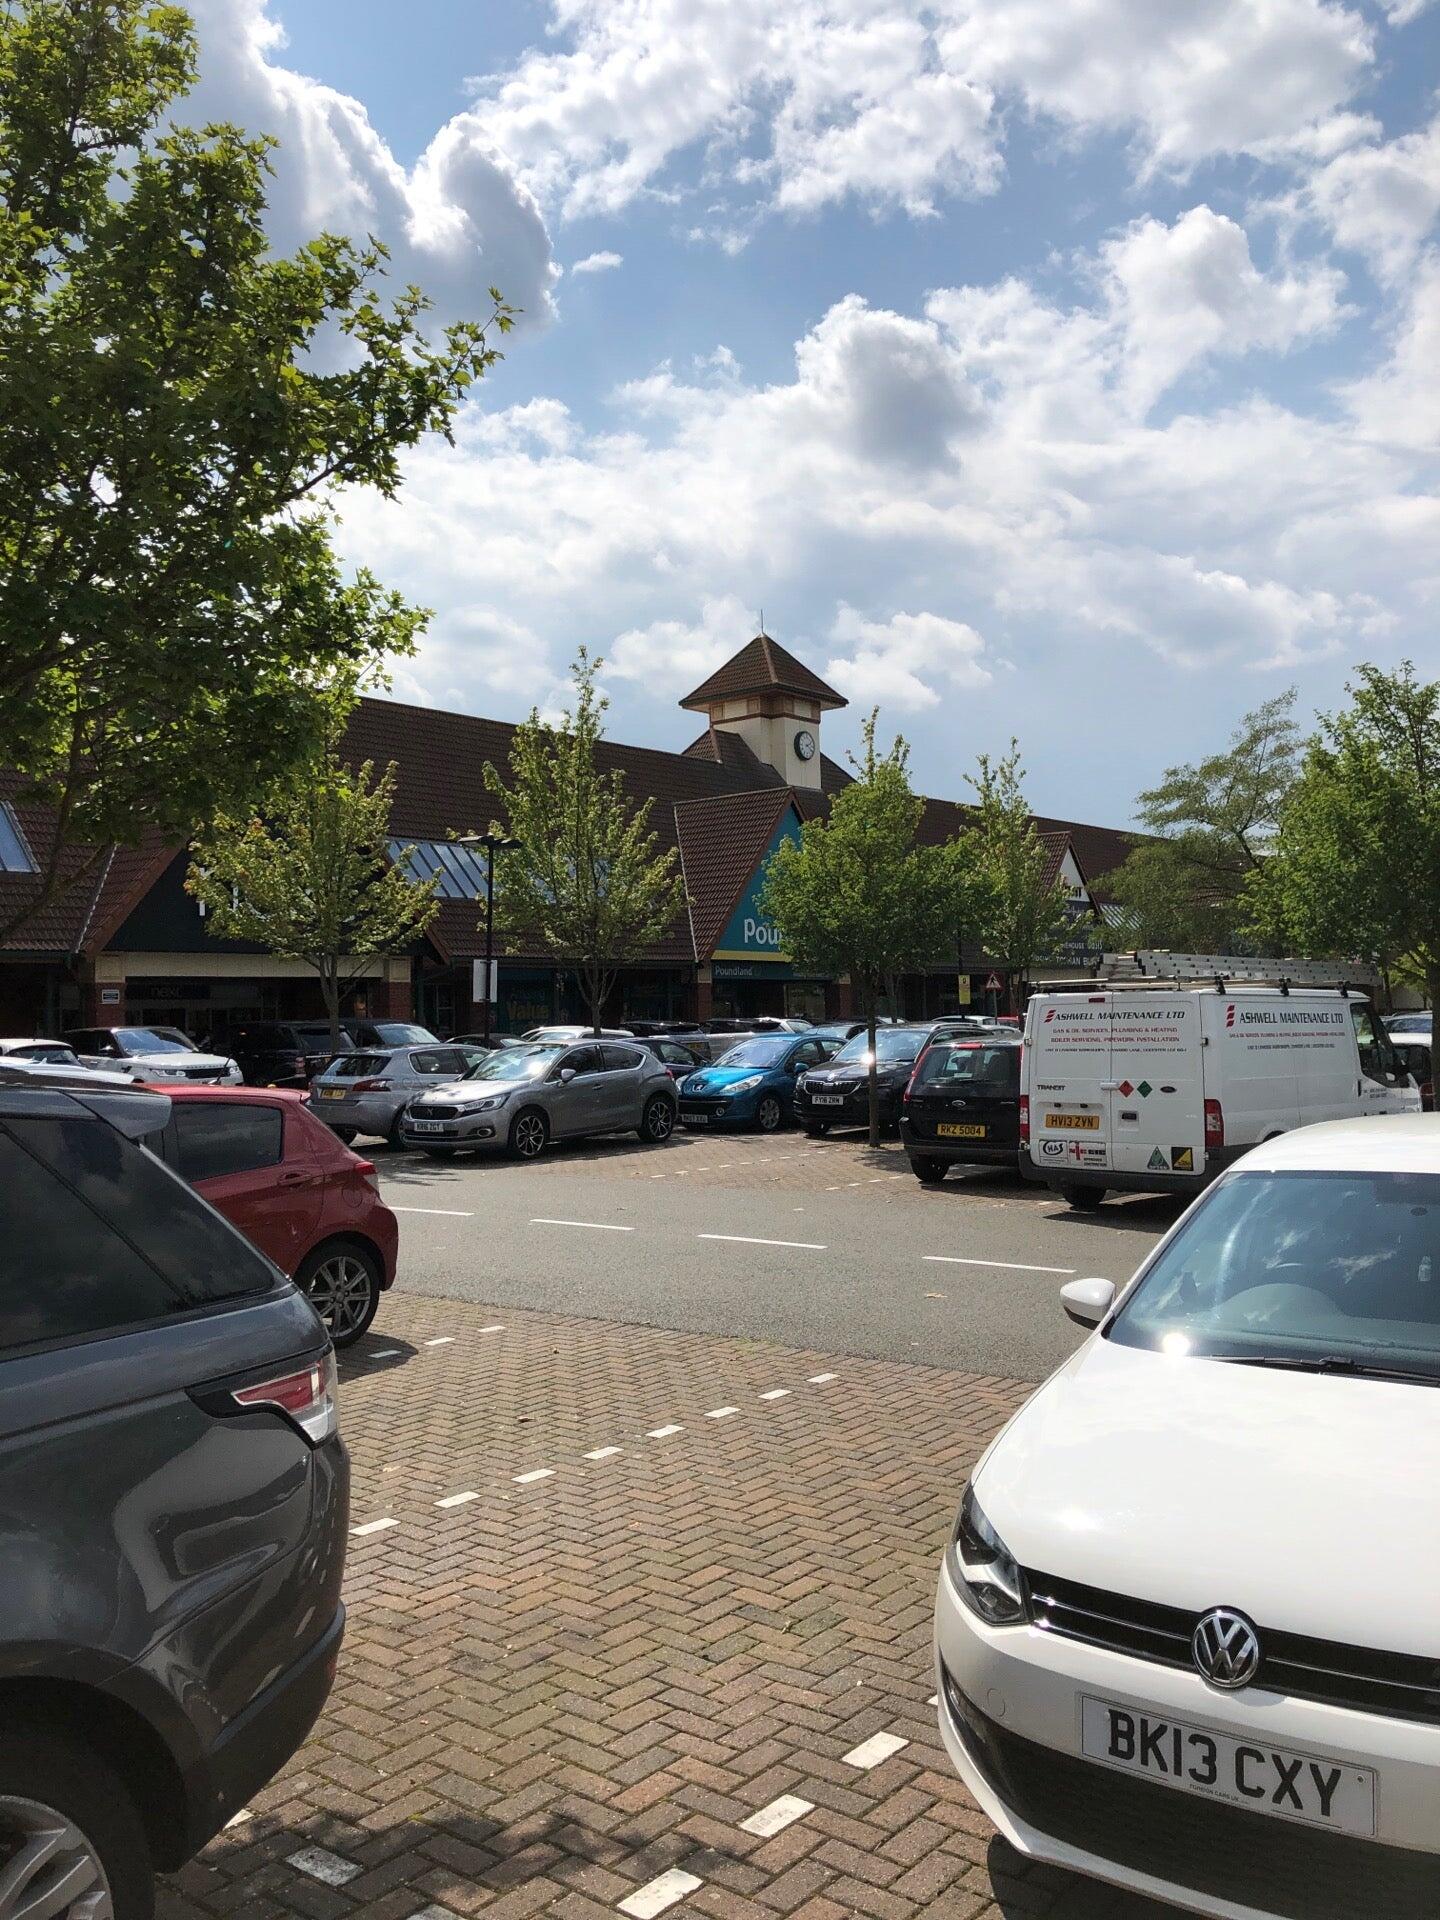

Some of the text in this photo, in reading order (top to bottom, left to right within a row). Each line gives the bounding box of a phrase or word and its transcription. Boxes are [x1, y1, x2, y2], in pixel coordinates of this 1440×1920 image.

[744, 918, 782, 945] Pou
[715, 966, 752, 976] Poundland
[1055, 1011, 1185, 1021] ASHWELL MAINTENANCE LTD
[1240, 1012, 1344, 1024] ASHWELL MAINTENANCE LTD
[1051, 1115, 1072, 1126] HV13
[941, 1125, 956, 1134] RKZ
[1108, 1709, 1342, 1817] BK13 CXY
